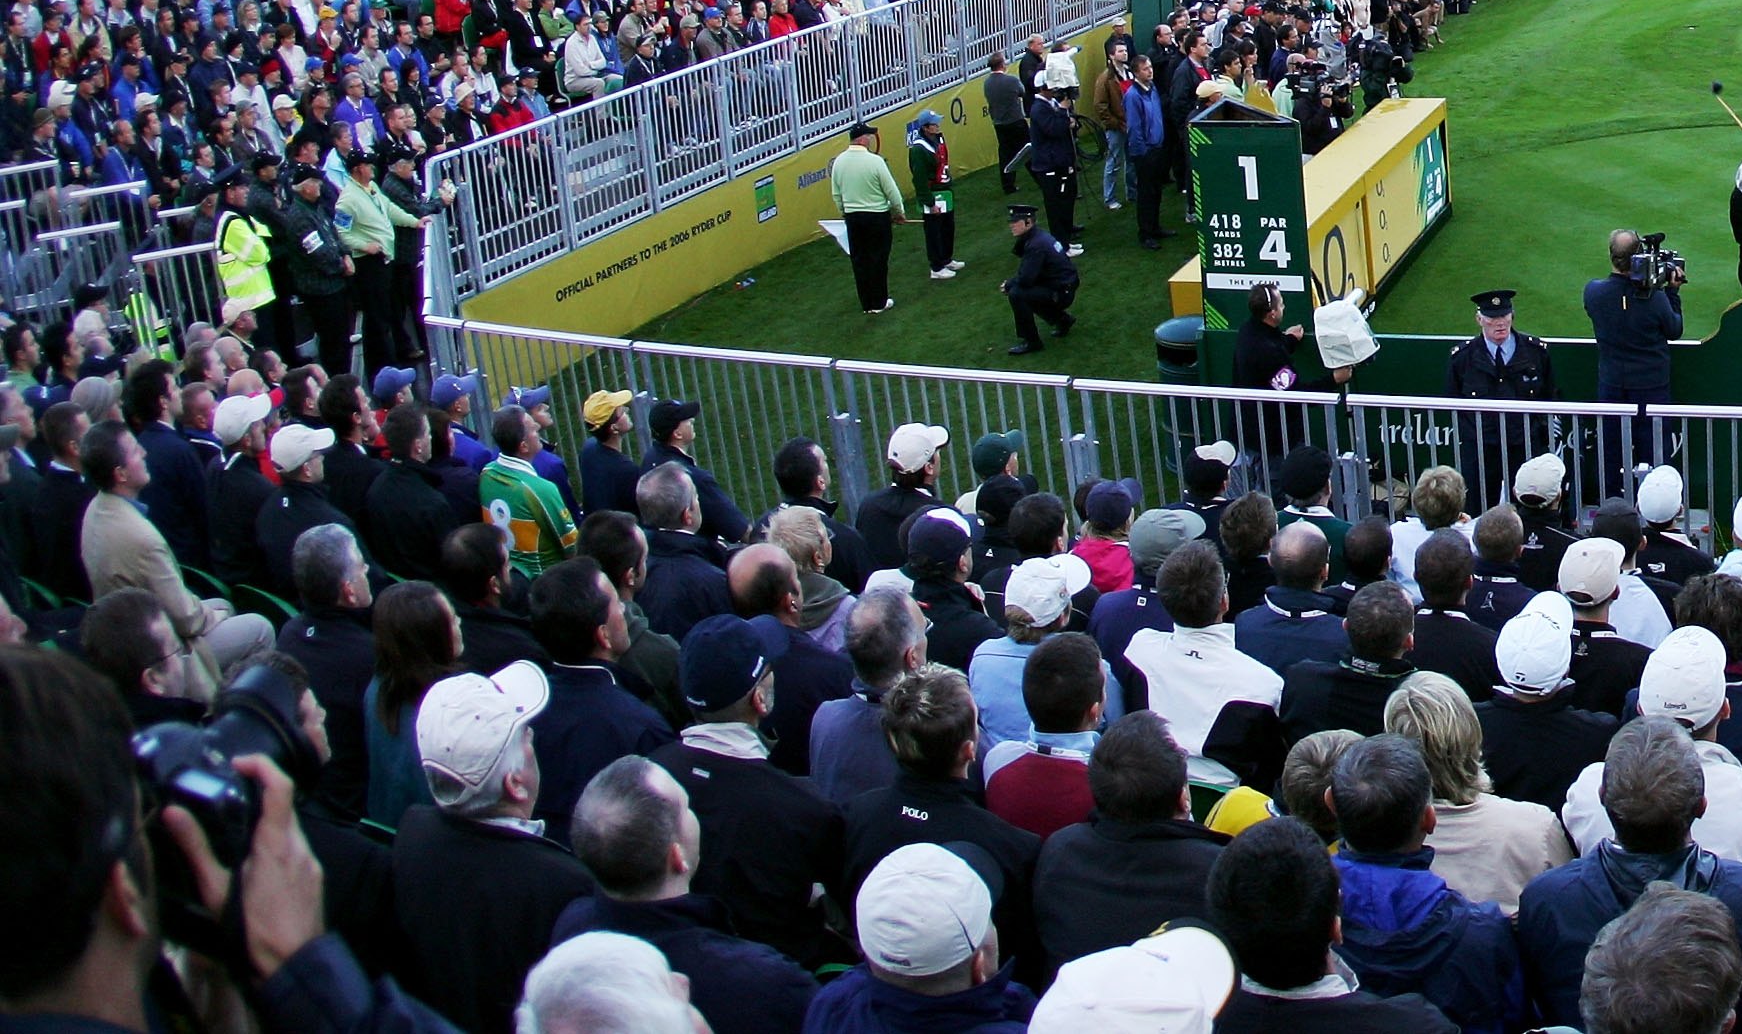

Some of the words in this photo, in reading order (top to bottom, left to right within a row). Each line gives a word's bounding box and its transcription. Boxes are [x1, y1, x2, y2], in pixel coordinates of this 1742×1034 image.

[1237, 155, 1259, 200] 1
[1209, 213, 1242, 229] 418
[1259, 217, 1287, 228] PAR
[1213, 230, 1241, 238] YARDS
[555, 275, 595, 302] OFFICIAL
[595, 254, 639, 284] PARTNERS
[639, 248, 651, 262] TO
[652, 239, 668, 255] THE
[669, 232, 690, 248] 2006
[691, 218, 716, 237] RYDER
[716, 209, 732, 225] CUP
[1212, 243, 1244, 258] 382
[1259, 230, 1292, 269] 4
[1213, 259, 1246, 267] METRES
[1229, 278, 1245, 286] THE
[901, 805, 929, 821] POLO
